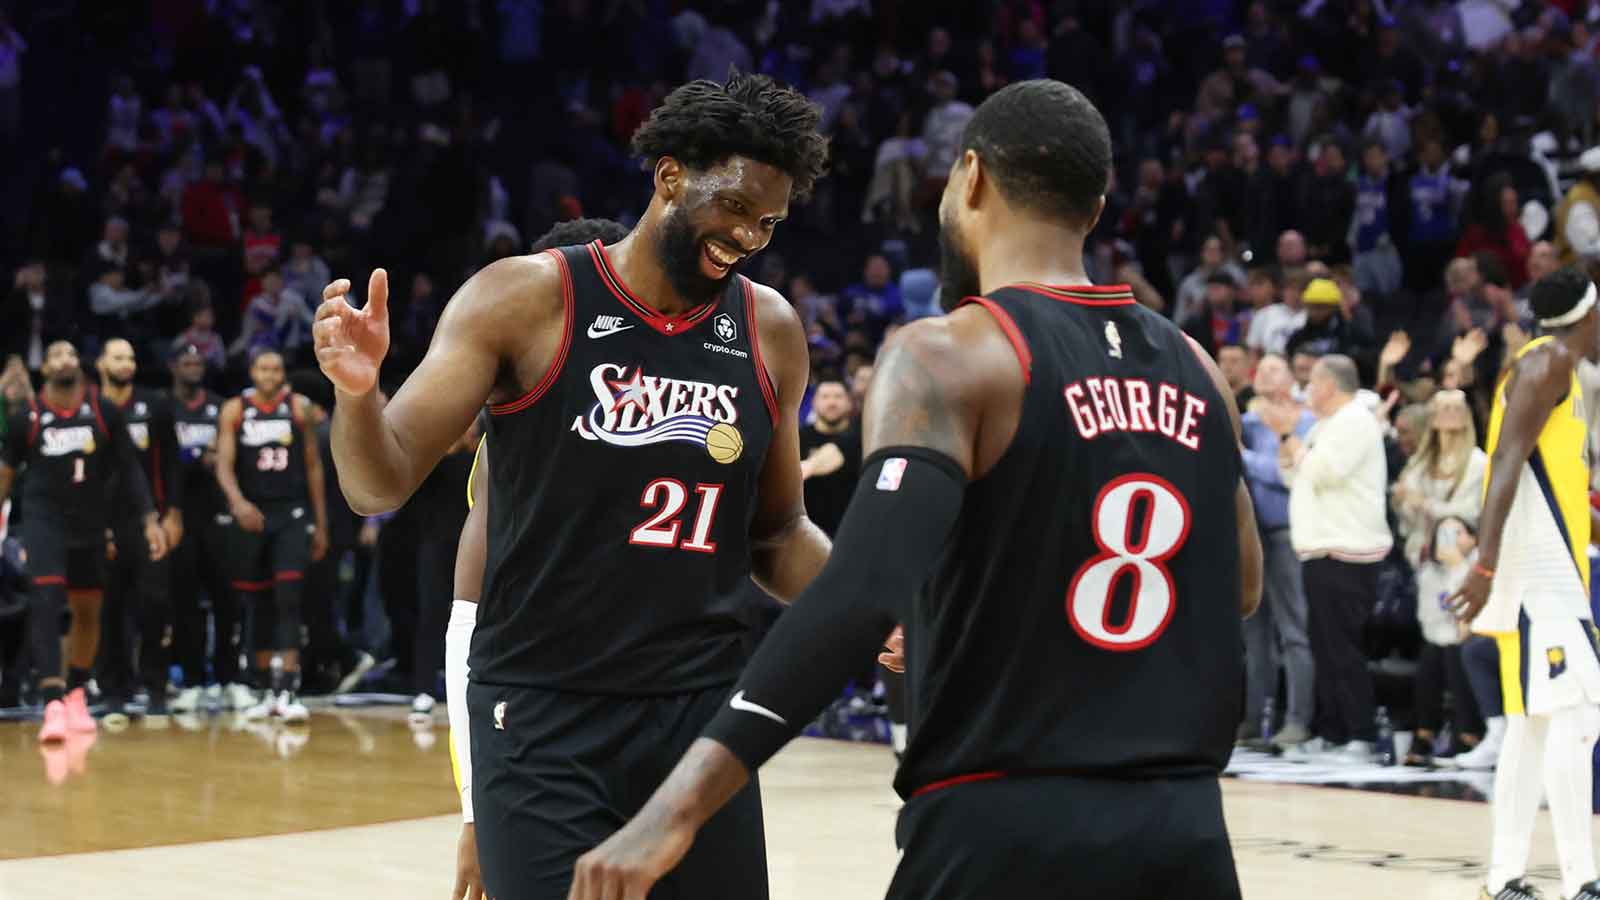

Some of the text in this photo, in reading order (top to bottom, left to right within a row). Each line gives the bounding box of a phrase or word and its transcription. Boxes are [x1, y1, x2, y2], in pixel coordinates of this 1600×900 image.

[594, 314, 625, 330] NIKE
[703, 341, 748, 359] crypto.com
[1063, 377, 1207, 450] GEORGE
[73, 457, 85, 482] 1
[257, 446, 289, 472] 33
[629, 477, 724, 553] 21
[1066, 472, 1191, 651] 8
